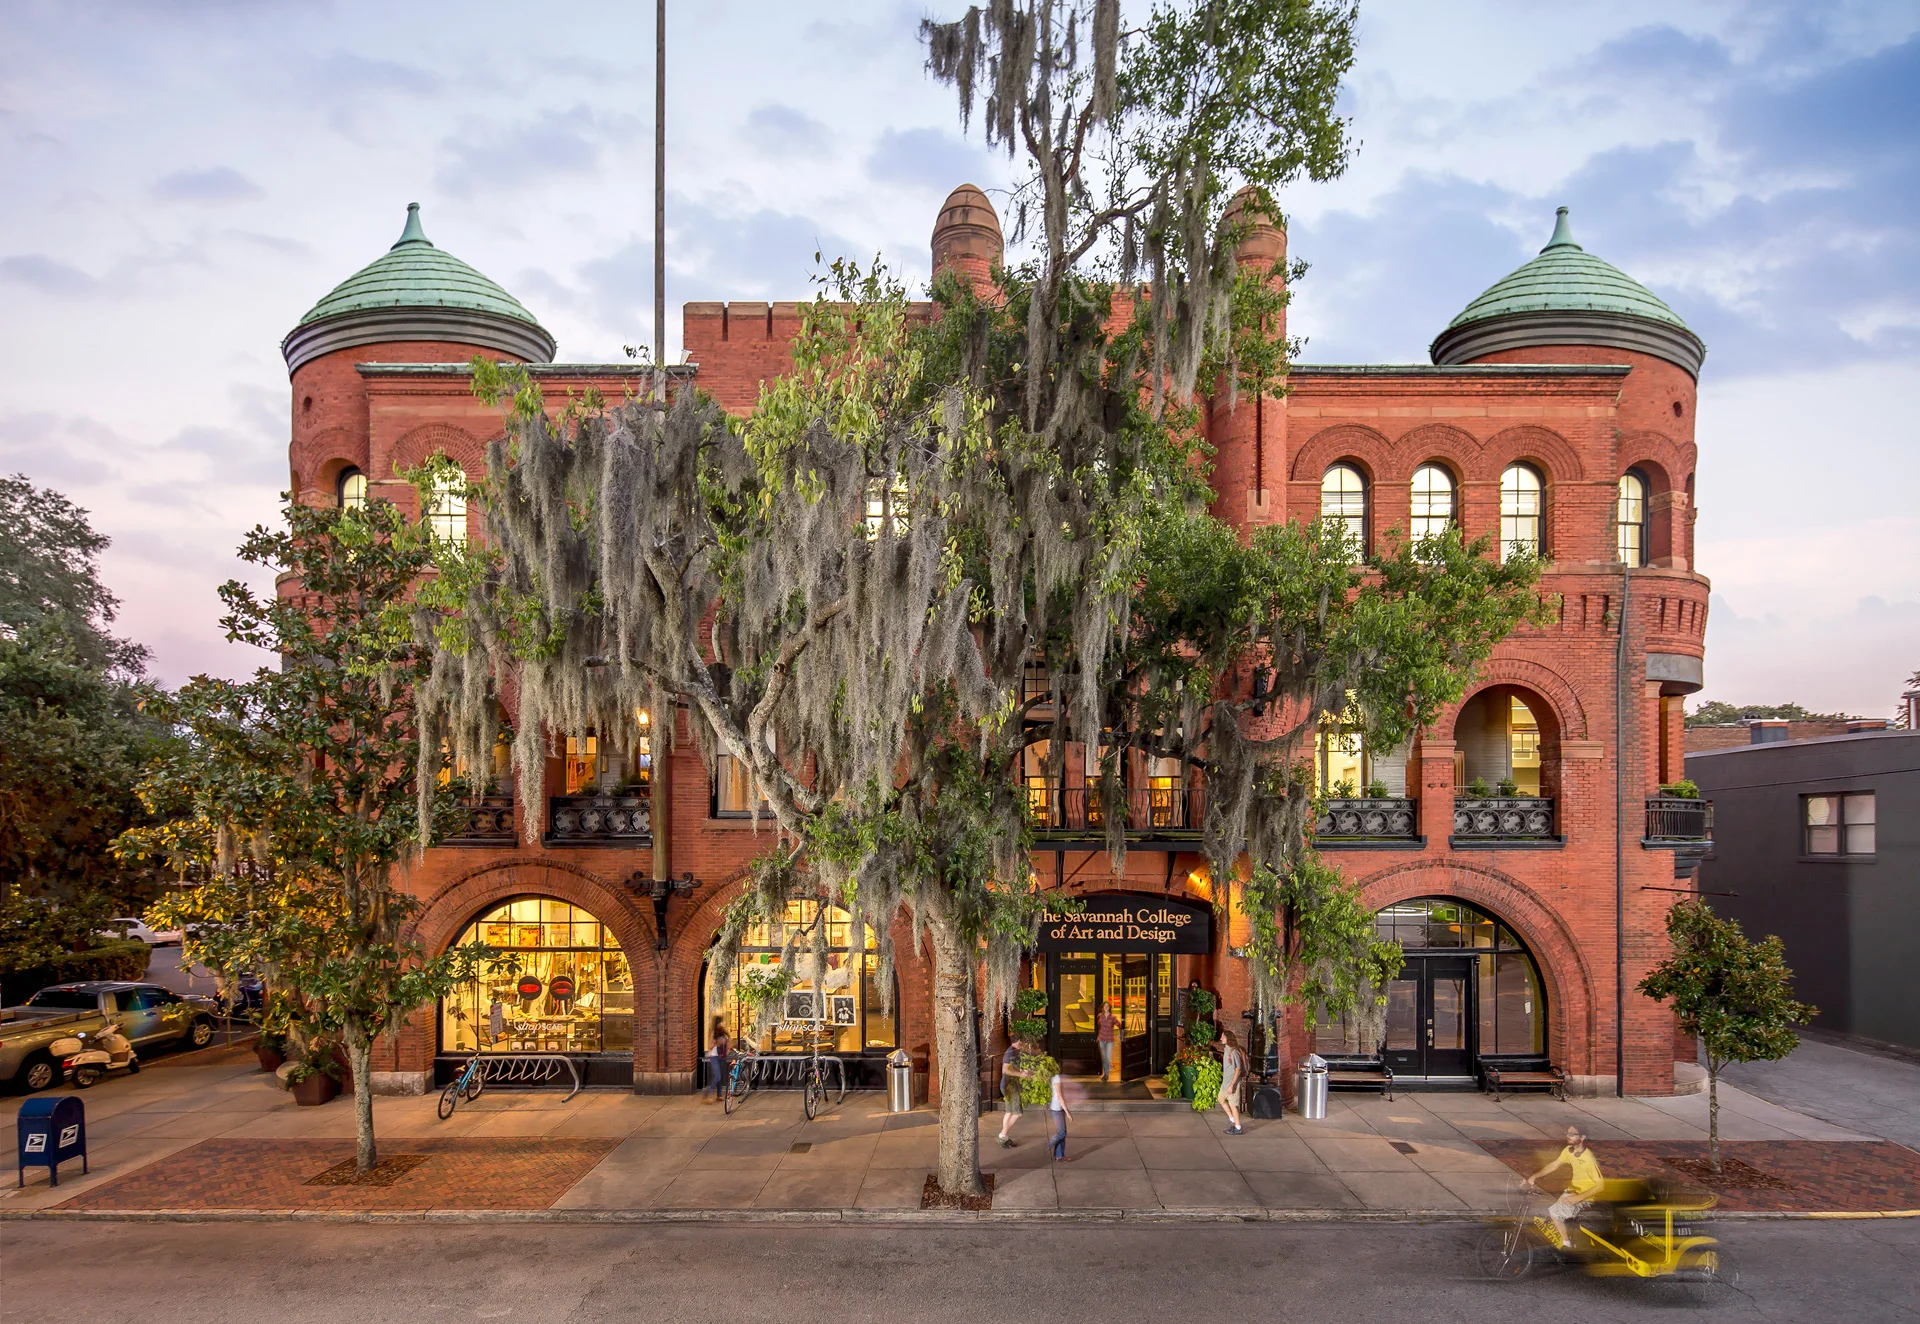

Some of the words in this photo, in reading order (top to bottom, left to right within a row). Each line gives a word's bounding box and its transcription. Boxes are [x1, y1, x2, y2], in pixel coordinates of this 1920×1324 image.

[1037, 906, 1061, 923] he
[1064, 908, 1134, 923] Savannah
[1136, 908, 1192, 927] College
[1050, 923, 1067, 939] of
[1068, 924, 1094, 939] Art
[1096, 924, 1124, 939] and
[1127, 925, 1177, 943] Design
